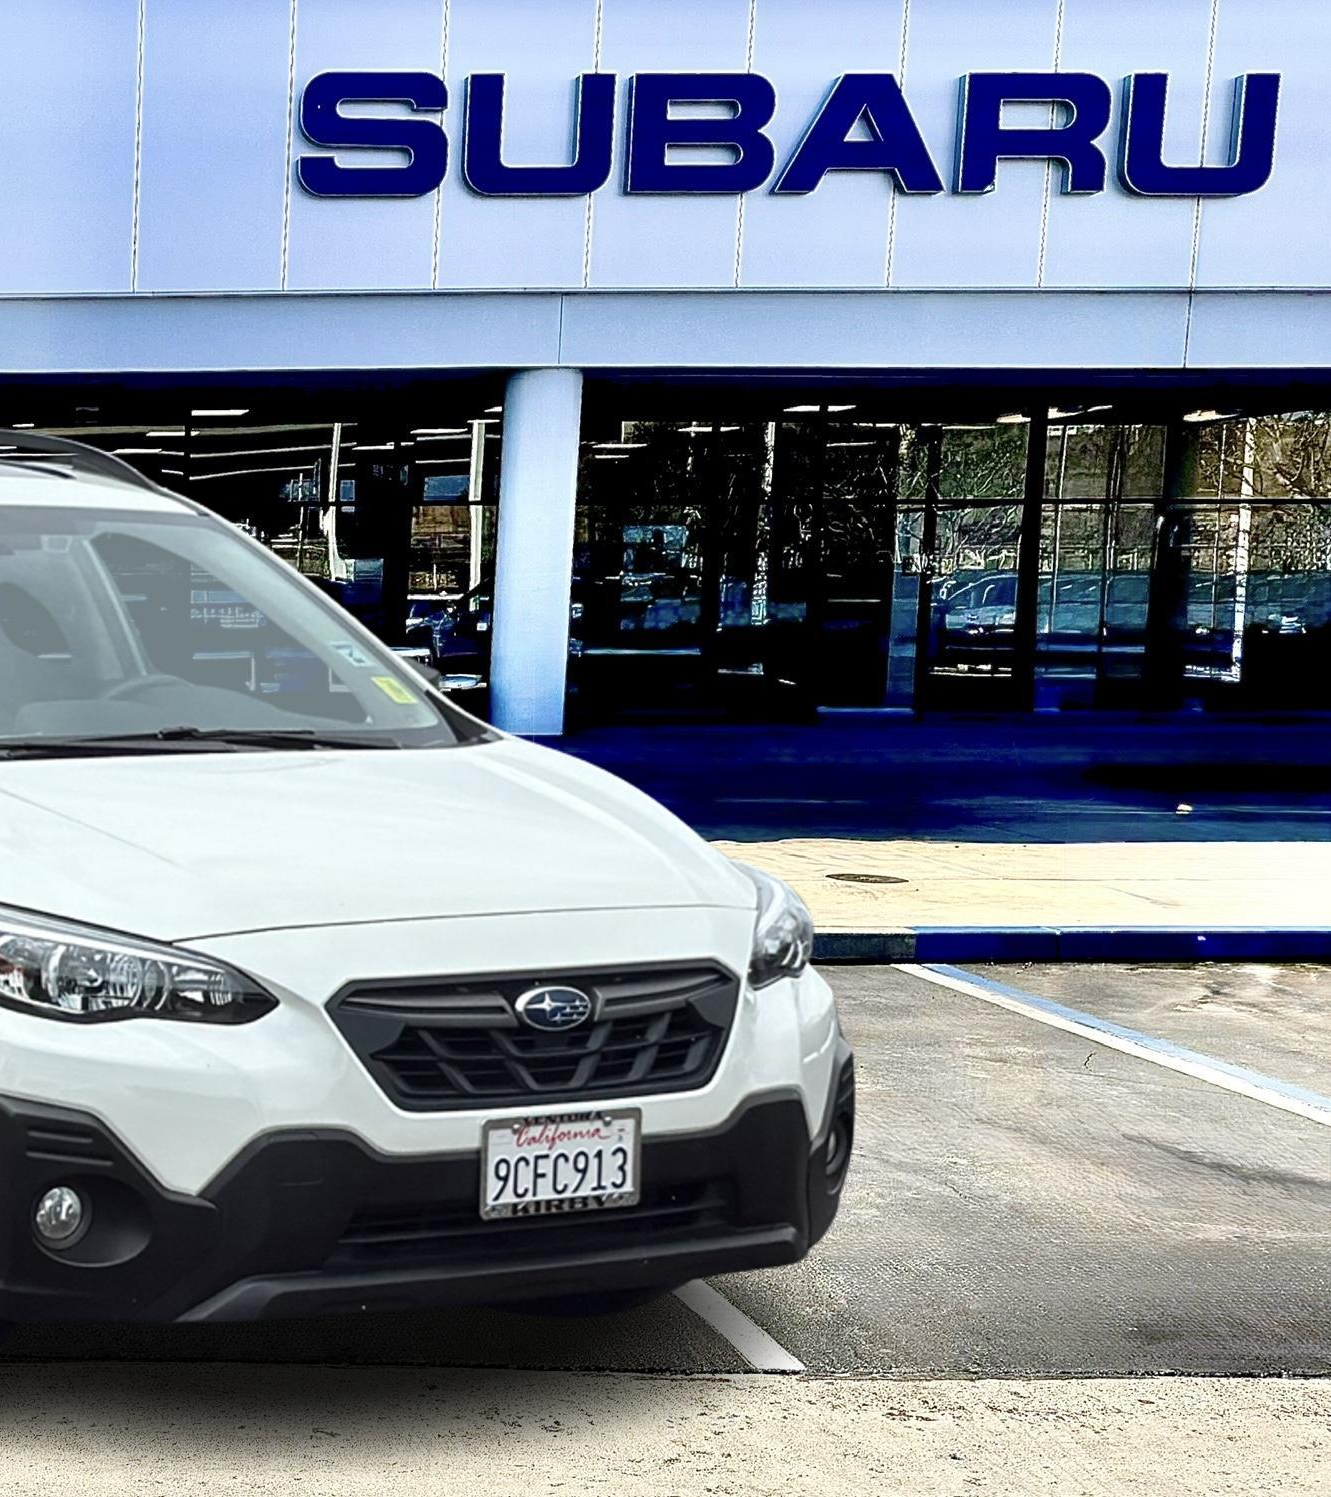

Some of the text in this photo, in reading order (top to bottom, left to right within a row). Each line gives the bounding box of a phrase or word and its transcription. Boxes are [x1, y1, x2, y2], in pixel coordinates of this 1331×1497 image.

[296, 71, 1282, 197] SUBARU
[515, 1124, 611, 1150] California
[492, 1146, 628, 1202] 9CFC913
[511, 1195, 611, 1215] KIRBY
